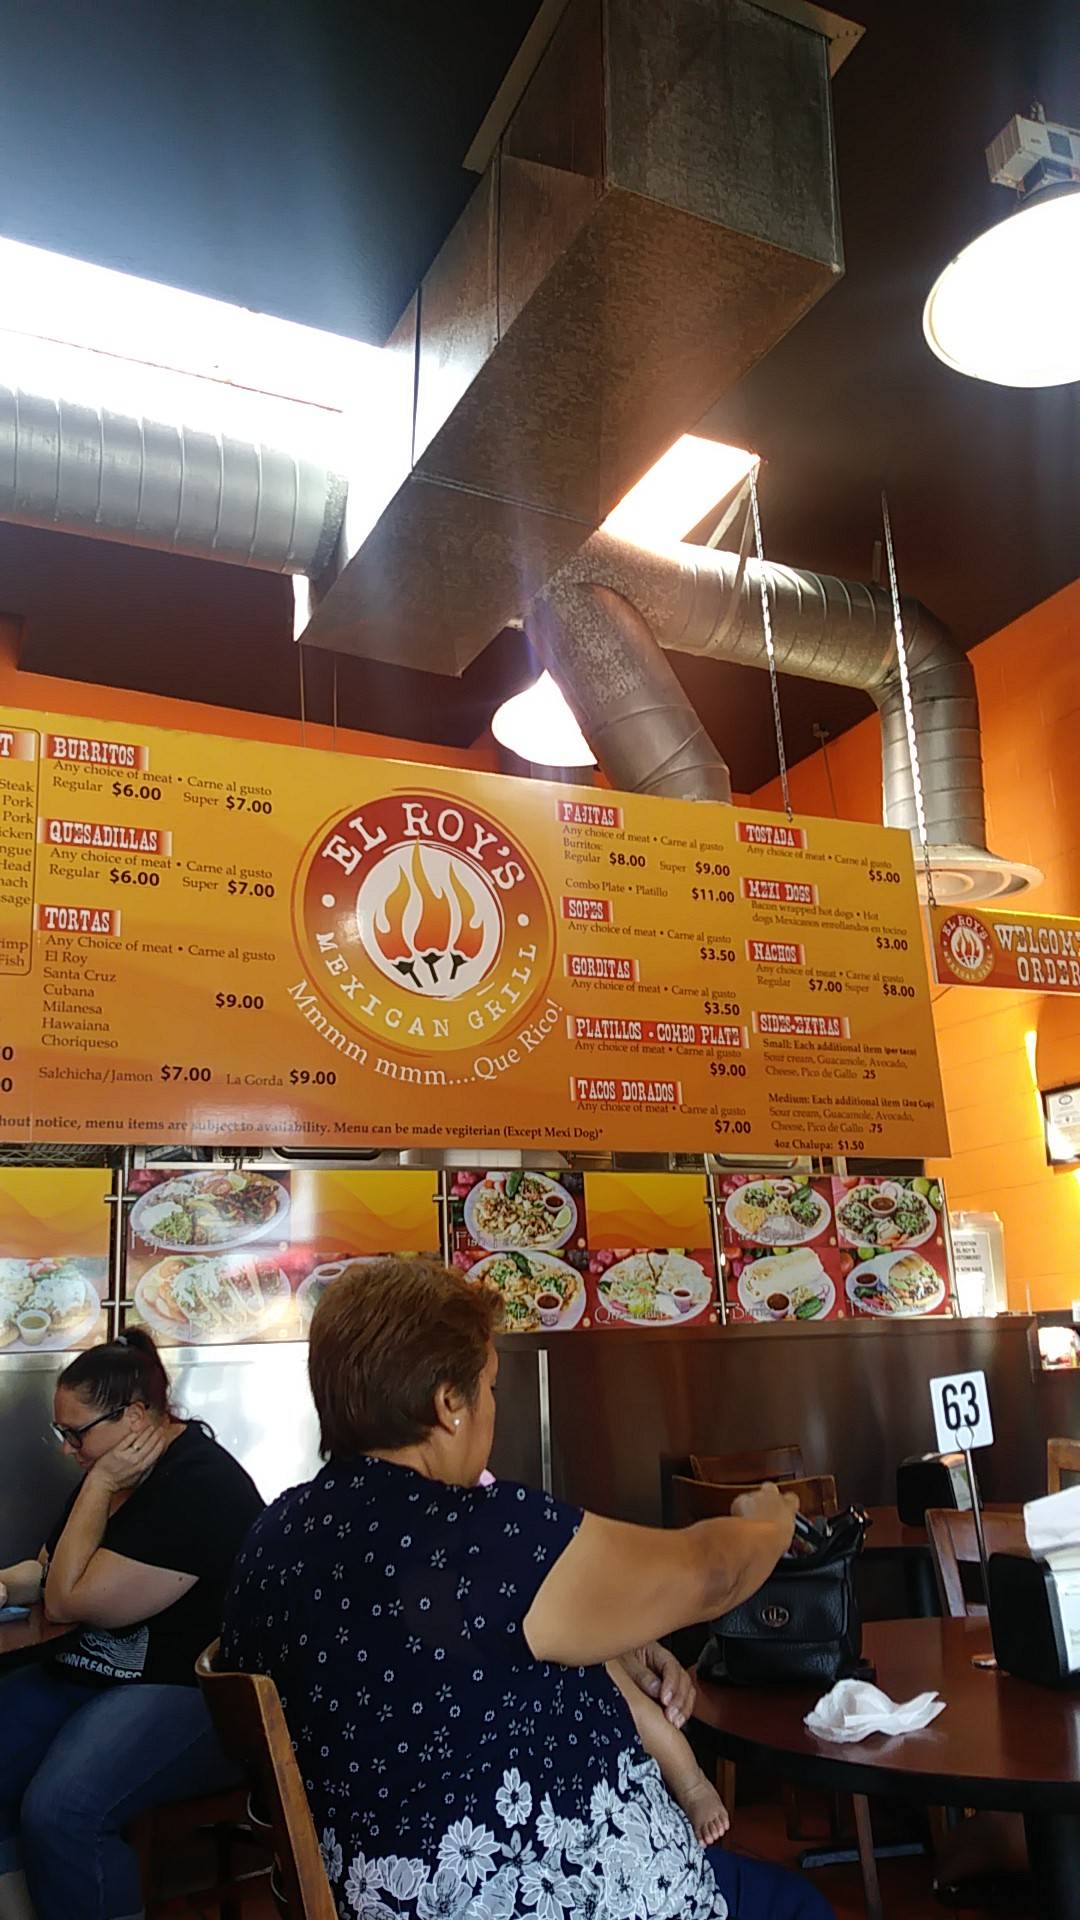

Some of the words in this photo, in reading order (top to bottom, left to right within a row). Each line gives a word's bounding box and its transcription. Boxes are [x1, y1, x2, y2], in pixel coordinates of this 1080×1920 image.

[53, 737, 135, 766] BURRITOS
[53, 760, 81, 775] Any
[84, 764, 123, 778] choice
[127, 768, 140, 779] of
[143, 772, 172, 784] meat
[187, 777, 222, 791] Carne
[240, 784, 272, 798] gusto
[3, 795, 34, 808] Pork
[53, 777, 103, 793] Regular
[112, 782, 161, 801] $6.00
[183, 792, 219, 808] Super
[226, 796, 272, 814] $7.00
[3, 810, 34, 824] Pork
[563, 803, 614, 826] FAJITAS
[50, 821, 157, 851] QUESADILLAS
[562, 825, 582, 836] Any
[584, 828, 614, 840] choice
[628, 834, 650, 843] meat
[660, 836, 687, 848] Carne
[700, 842, 724, 852] gusto
[746, 825, 795, 846] TOSTADA
[322, 817, 388, 875] EL
[402, 803, 525, 890] ROY'S
[50, 848, 77, 862] Any
[80, 851, 121, 865] choice
[125, 855, 138, 866] of
[141, 858, 171, 869] meat
[186, 862, 222, 876] Carne
[239, 868, 272, 882] gusto
[564, 850, 601, 863] Regular
[609, 852, 645, 867] $8.00
[659, 861, 686, 874] Super
[695, 861, 730, 876] $9.00
[50, 864, 100, 881] Regular
[110, 869, 160, 887] $6.00
[183, 877, 219, 892] Super
[228, 880, 274, 898] $7.00
[869, 869, 900, 883] $5.00
[566, 878, 600, 891] Combo
[602, 882, 625, 892] Plate
[636, 884, 668, 897] Platillo
[692, 888, 734, 903] $11.00
[748, 880, 780, 900] MEXI
[785, 883, 811, 902] DOGS
[569, 900, 603, 919] SOPES
[779, 904, 816, 918] wrapped
[45, 907, 110, 933] TORTAS
[568, 921, 587, 932] Any
[590, 924, 620, 935] choice
[634, 928, 656, 937] meat
[667, 930, 694, 941] Carne
[707, 935, 731, 945] gusto
[993, 924, 1080, 957] WELCOM
[46, 936, 73, 949] Any
[78, 937, 123, 951] Choice
[126, 940, 139, 951] of
[142, 943, 172, 953] meat
[188, 945, 225, 958] Carne
[242, 951, 276, 963] gusto
[754, 943, 797, 963] NACHOS
[876, 937, 908, 950] $3.00
[45, 951, 58, 963] El
[62, 952, 88, 966] Roy
[700, 947, 735, 962] $3.50
[43, 968, 80, 981] Santa
[84, 970, 117, 982] Cruz
[572, 957, 630, 979] GORDITAS
[43, 984, 95, 998] Cubana
[316, 932, 449, 1037] MEXICAN
[468, 944, 537, 1029] GRILL
[571, 979, 592, 990] Any
[594, 981, 624, 992] choice
[638, 985, 660, 994] meat
[671, 985, 699, 996] Carne
[712, 990, 736, 999] gusto
[757, 976, 790, 988] Regular
[809, 979, 842, 992] $7.00
[883, 983, 915, 998] $8.00
[43, 1001, 103, 1015] Milanesa
[215, 993, 264, 1010] $9.00
[704, 1001, 740, 1016] $3.50
[41, 1018, 110, 1032] Hawaiana
[576, 1018, 641, 1040] PLATILLOS
[657, 1023, 695, 1043] COMBO
[701, 1025, 740, 1046] PLATE
[41, 1034, 118, 1051] Choriqueso
[574, 1040, 595, 1051] Any
[597, 1041, 628, 1053] choice
[642, 1045, 665, 1054] meat
[676, 1045, 704, 1056] Carne
[763, 1038, 792, 1049] Small:
[794, 1041, 815, 1050] Each
[817, 1041, 861, 1053] additional
[38, 1067, 153, 1084] Salchicha/Jamon
[161, 1064, 212, 1082] $7.00
[226, 1074, 242, 1086] La
[244, 1074, 283, 1087] Gorda
[289, 1069, 337, 1086] $9.00
[710, 1062, 746, 1077] $9.00
[578, 1080, 615, 1100] TACOS
[622, 1081, 674, 1102] DORADOS
[812, 1095, 833, 1105] Each
[835, 1096, 879, 1107] additional
[577, 1101, 598, 1112] Any
[600, 1101, 631, 1113] choice
[646, 1105, 668, 1113] meat
[680, 1104, 708, 1115] Carne
[35, 1116, 81, 1130] notice,
[86, 1119, 124, 1129] menu
[128, 1118, 164, 1130] items
[168, 1122, 187, 1131] are
[334, 1121, 369, 1134] Menu
[372, 1125, 392, 1134] can
[395, 1123, 409, 1134] be
[412, 1124, 442, 1135] made
[445, 1125, 500, 1139] vegiterian
[504, 1125, 541, 1140] (Except
[544, 1126, 571, 1138] Mexi
[714, 1119, 751, 1134] $7.00
[869, 1123, 883, 1133] .75
[792, 1139, 833, 1151] Chalupa:
[838, 1140, 864, 1150] $1.50
[942, 1380, 980, 1431] 63
